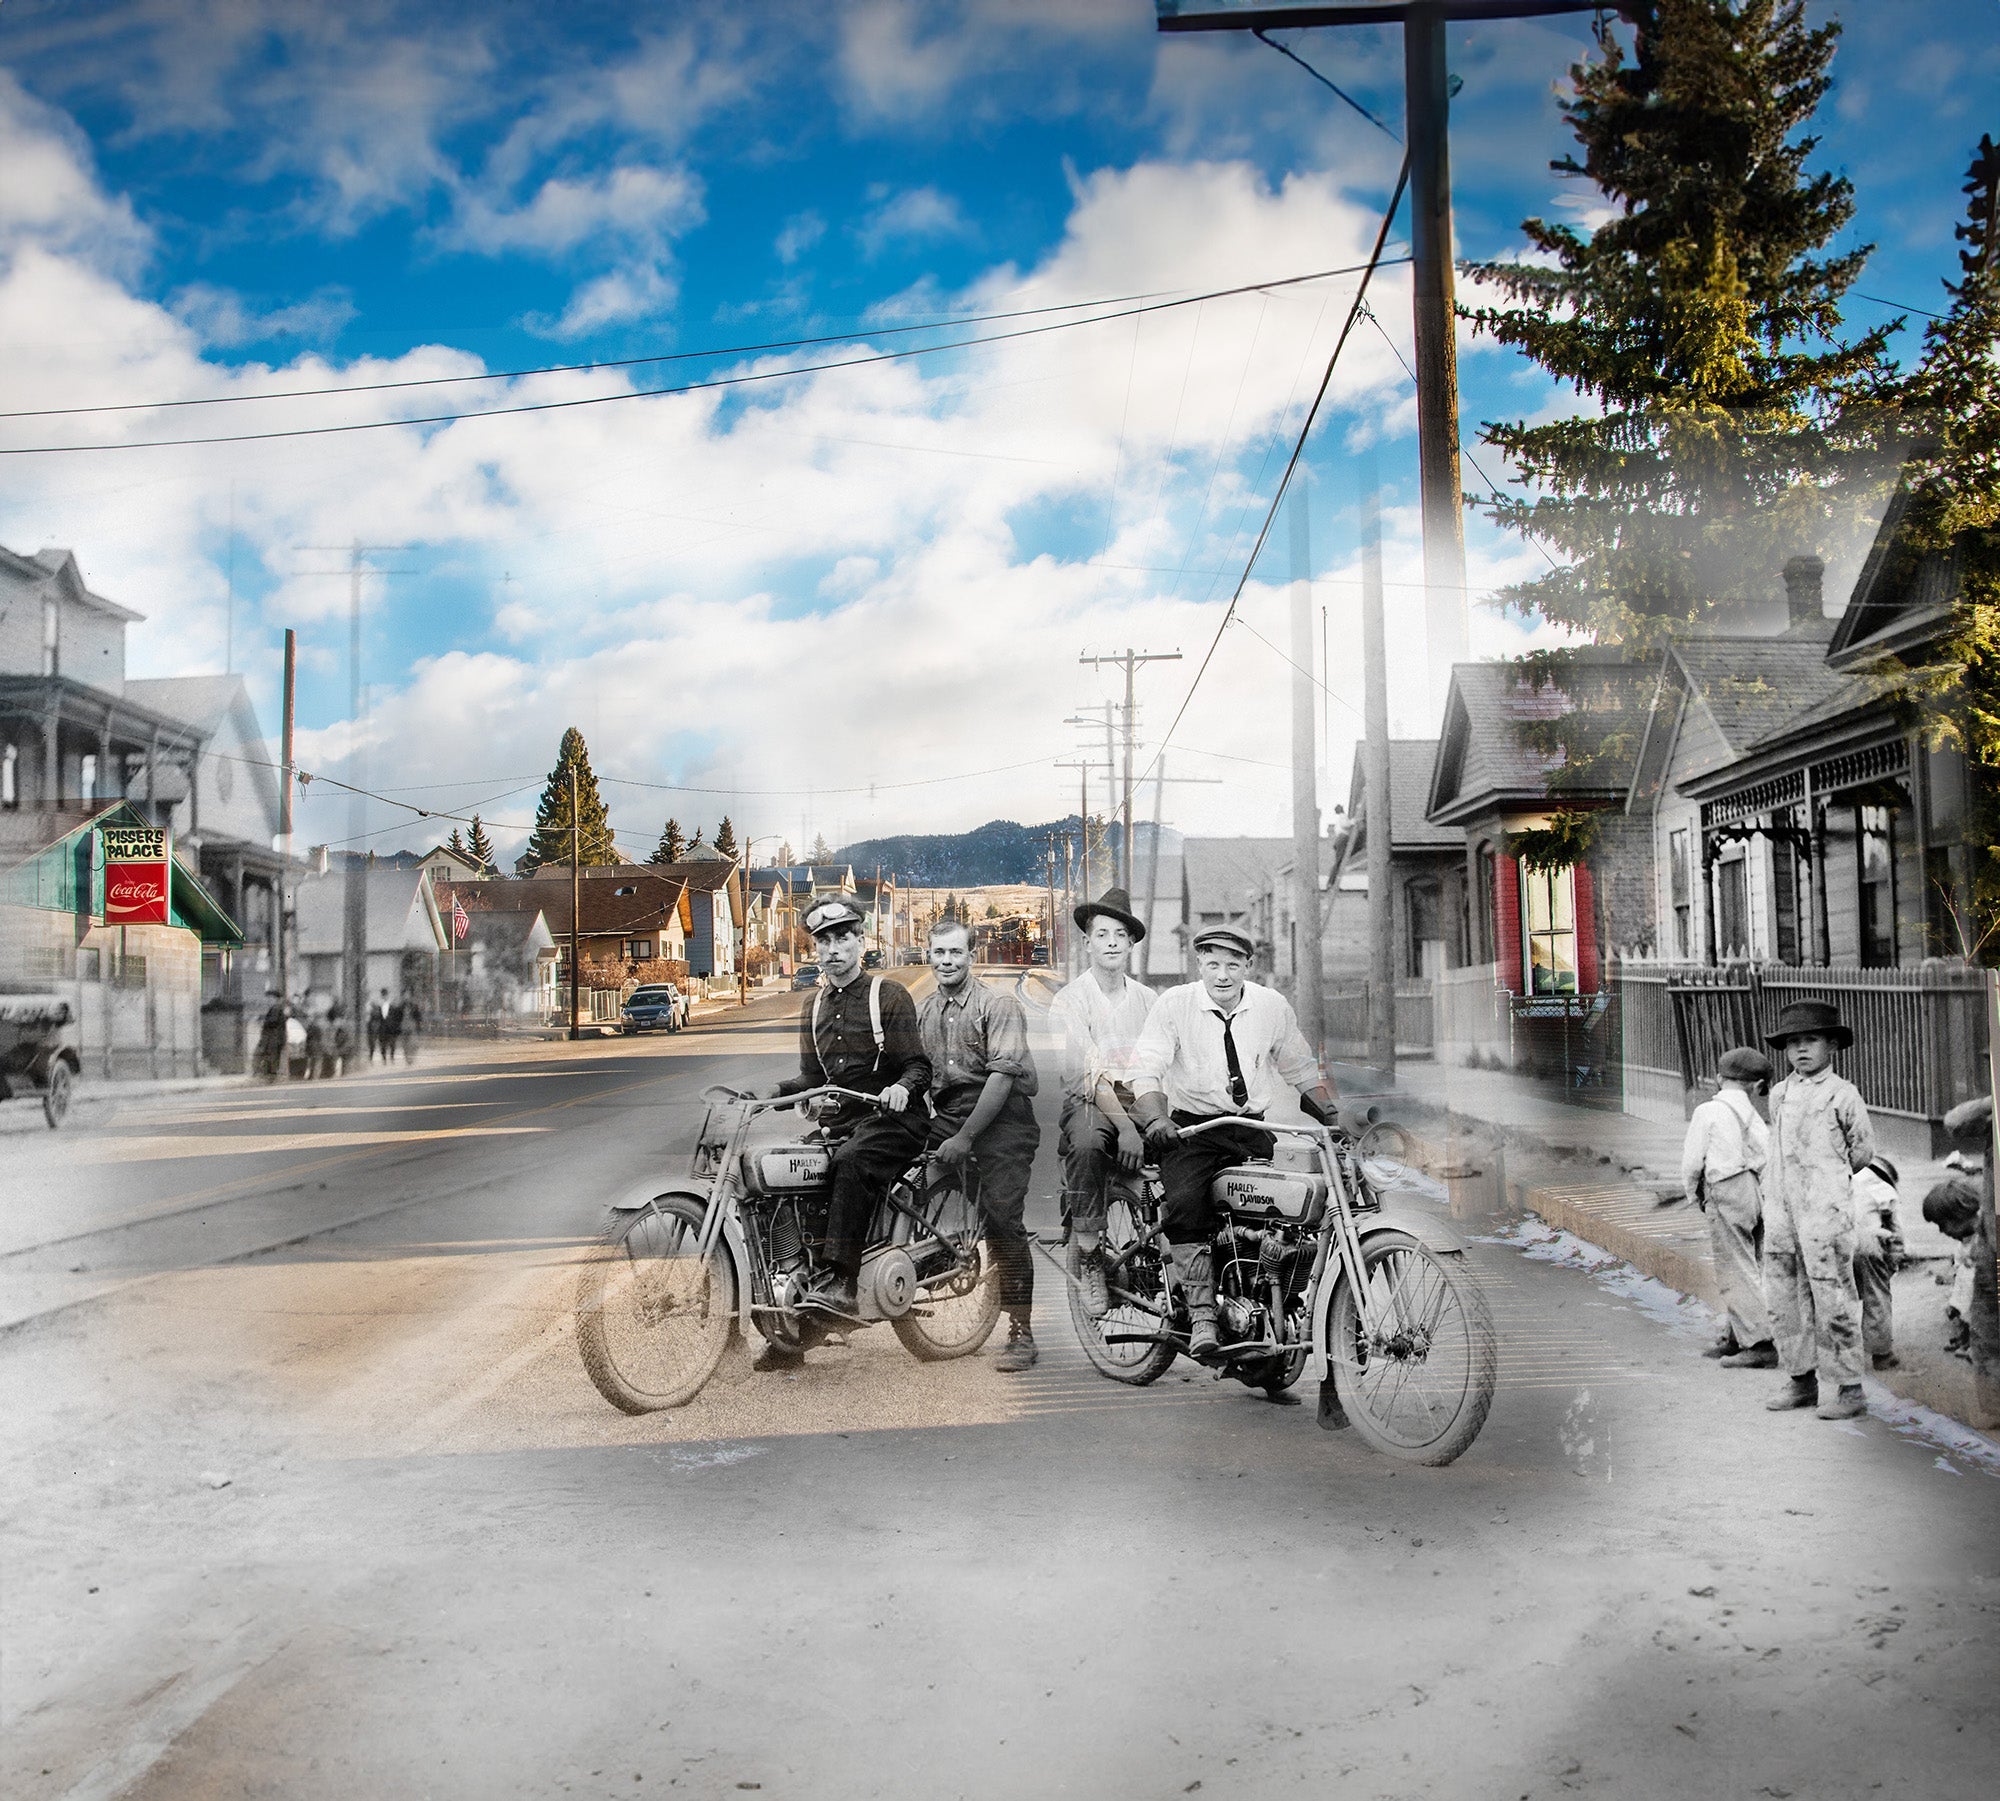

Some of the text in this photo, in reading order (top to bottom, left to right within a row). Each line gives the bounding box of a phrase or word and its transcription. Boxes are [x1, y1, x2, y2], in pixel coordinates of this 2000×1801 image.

[105, 829, 164, 844] PISSER'S
[106, 844, 163, 858] PALACE
[1227, 1182, 1258, 1197] HARLEY-
[1240, 1194, 1275, 1207] DAVIDSON
